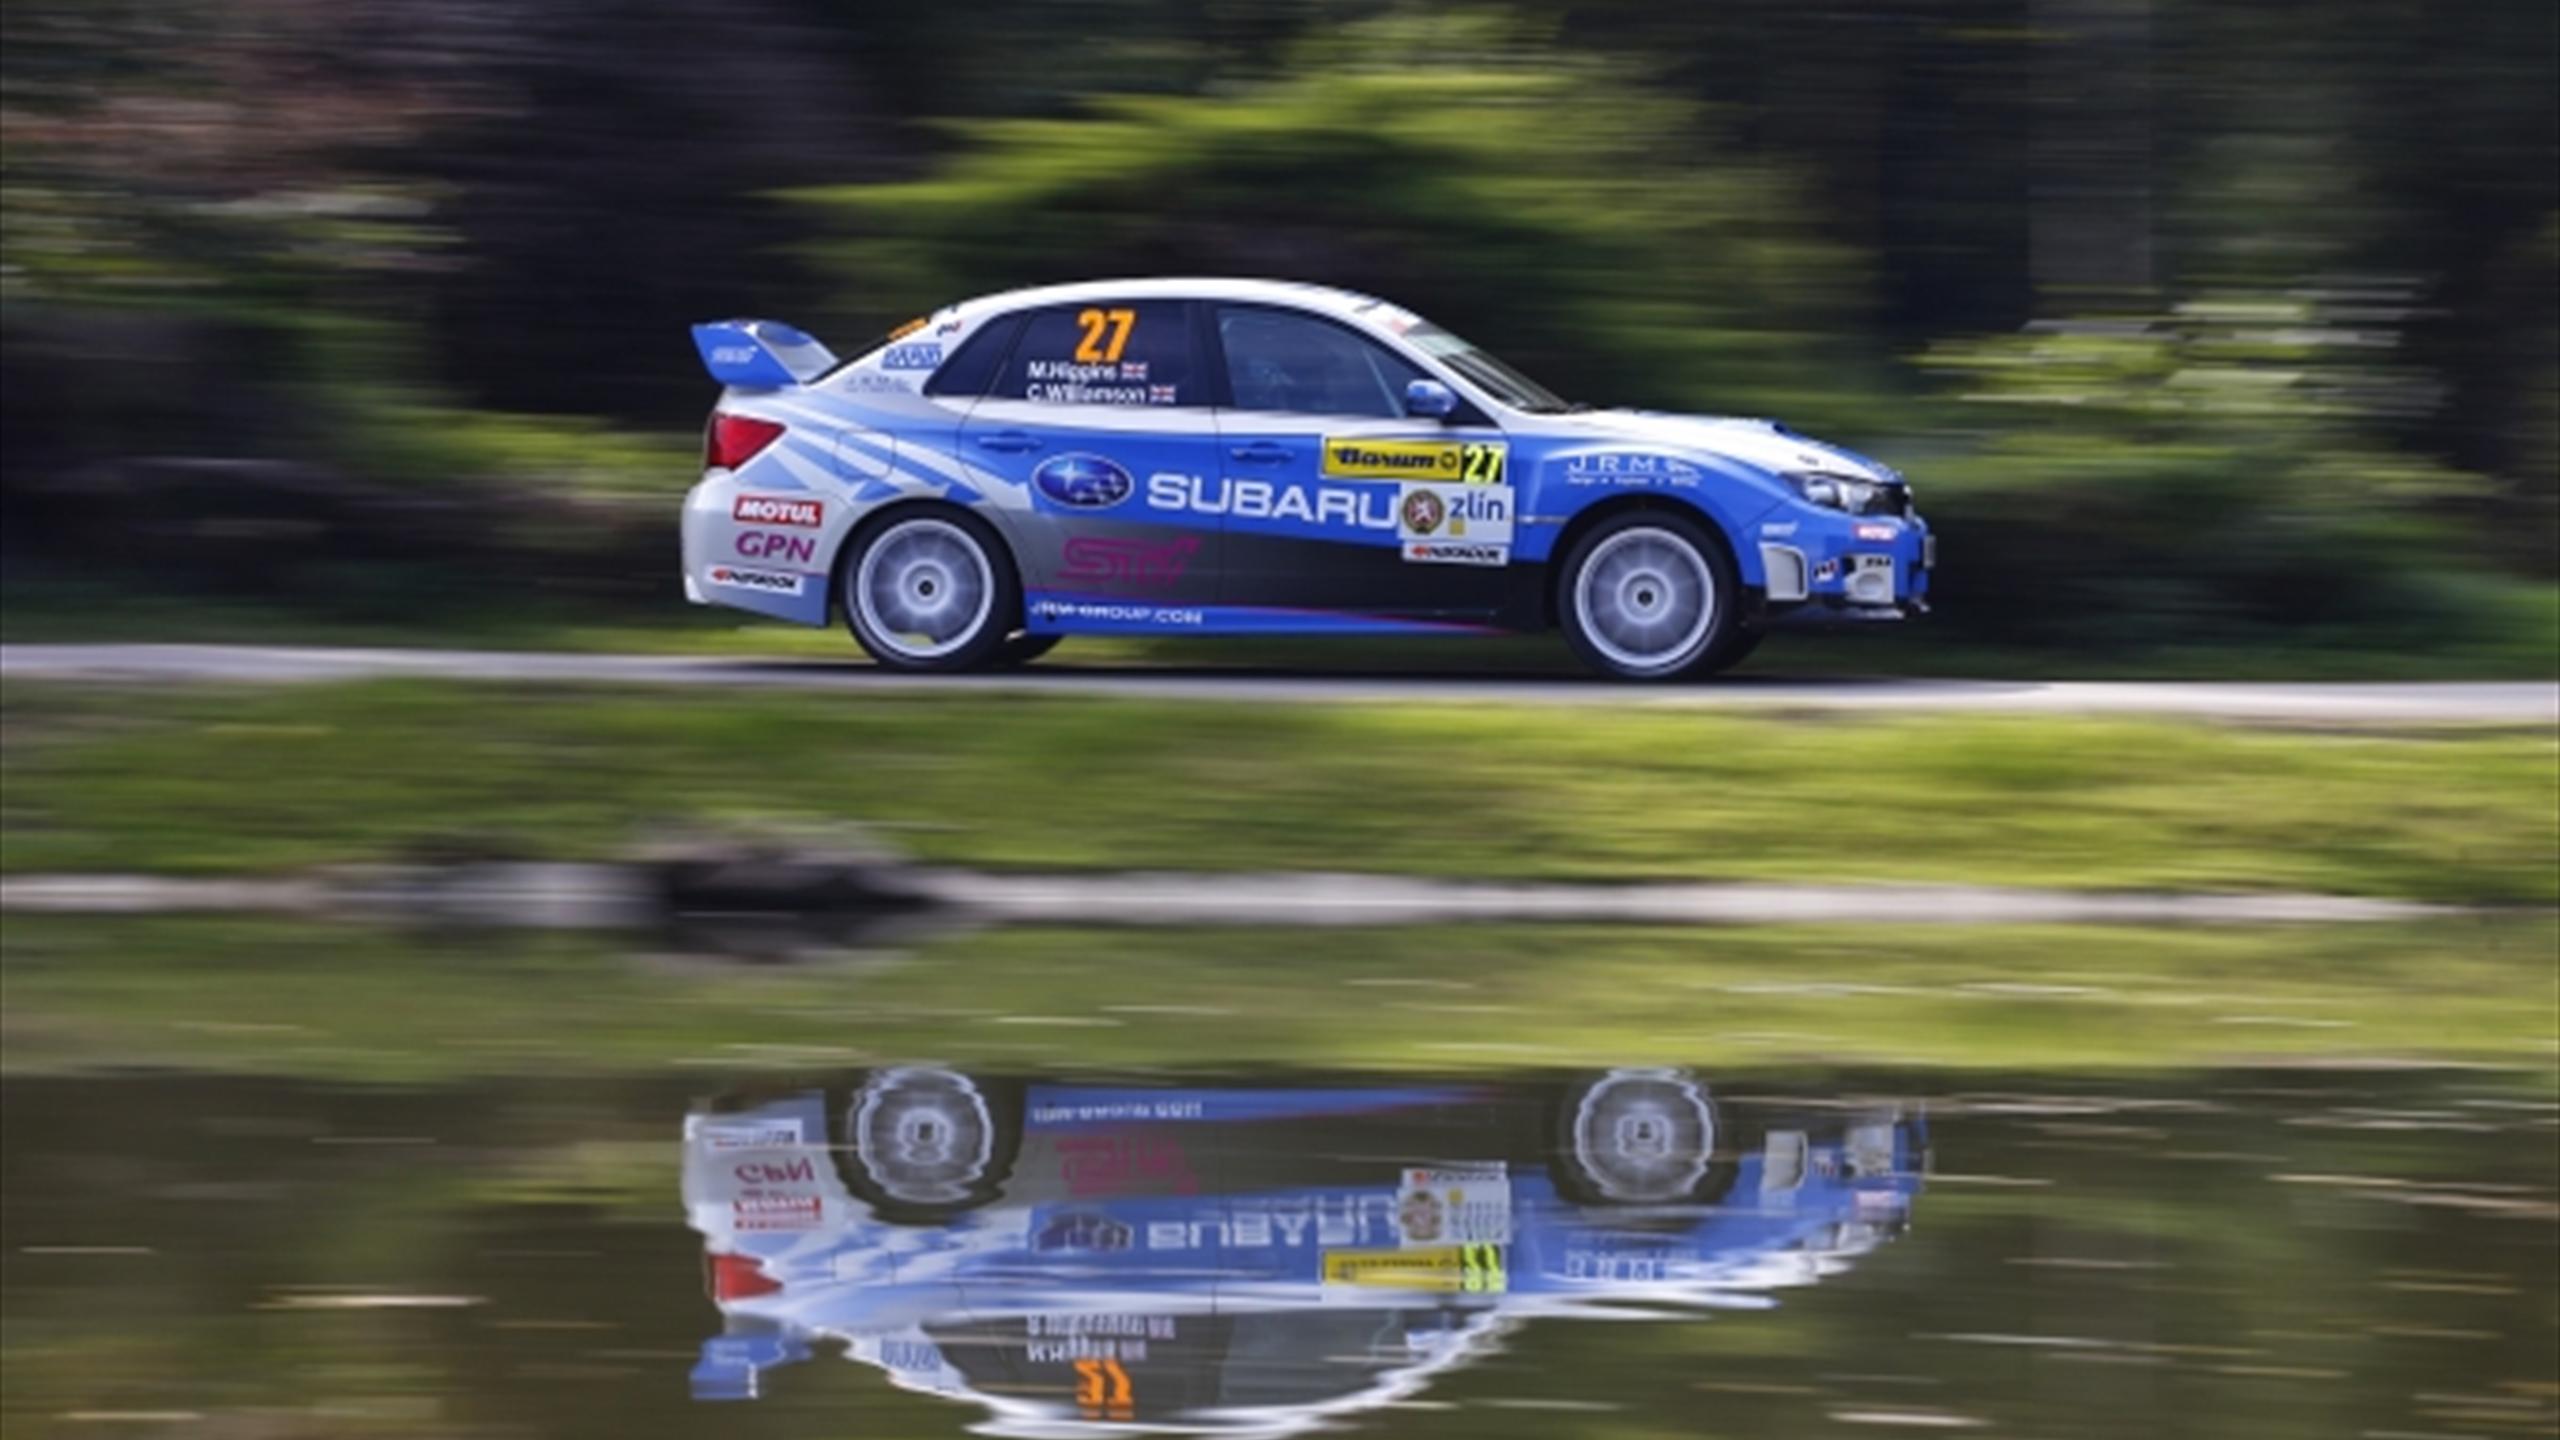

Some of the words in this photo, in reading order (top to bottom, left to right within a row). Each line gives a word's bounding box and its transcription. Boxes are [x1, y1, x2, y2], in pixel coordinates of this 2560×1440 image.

[1075, 309, 1135, 362] 27
[1464, 444, 1503, 483] 27
[737, 500, 818, 524] MOTUL
[1147, 473, 1400, 530] SUBARU
[1450, 490, 1505, 521] zlín
[735, 530, 816, 563] GPN
